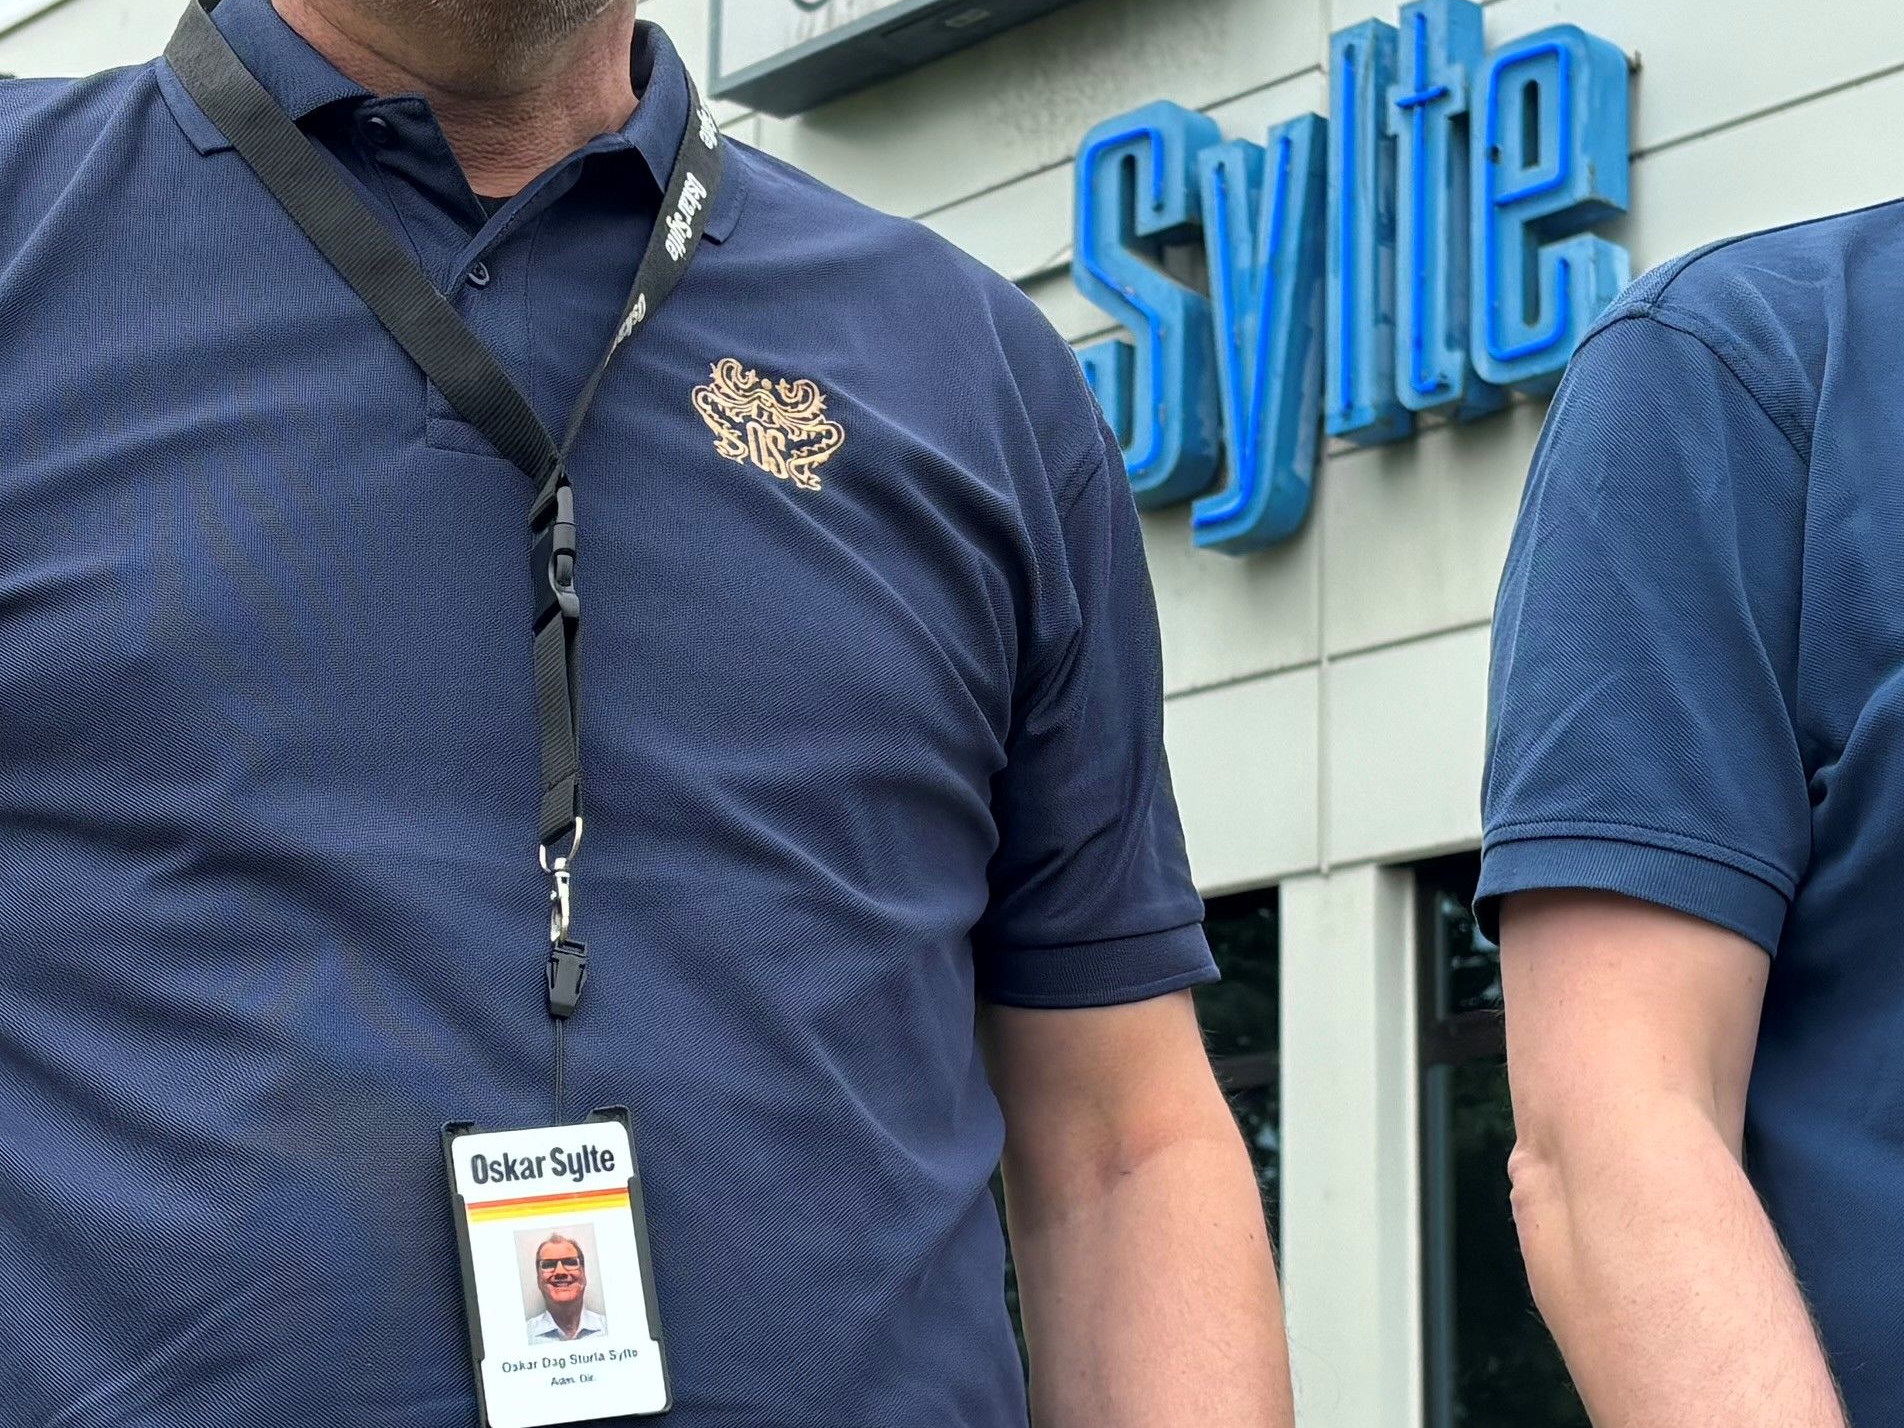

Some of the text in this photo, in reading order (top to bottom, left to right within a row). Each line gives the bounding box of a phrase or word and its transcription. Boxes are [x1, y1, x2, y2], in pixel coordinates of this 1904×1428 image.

[746, 421, 788, 479] OS
[471, 1145, 615, 1185] Oskar Sylte
[541, 1357, 566, 1369] Dag
